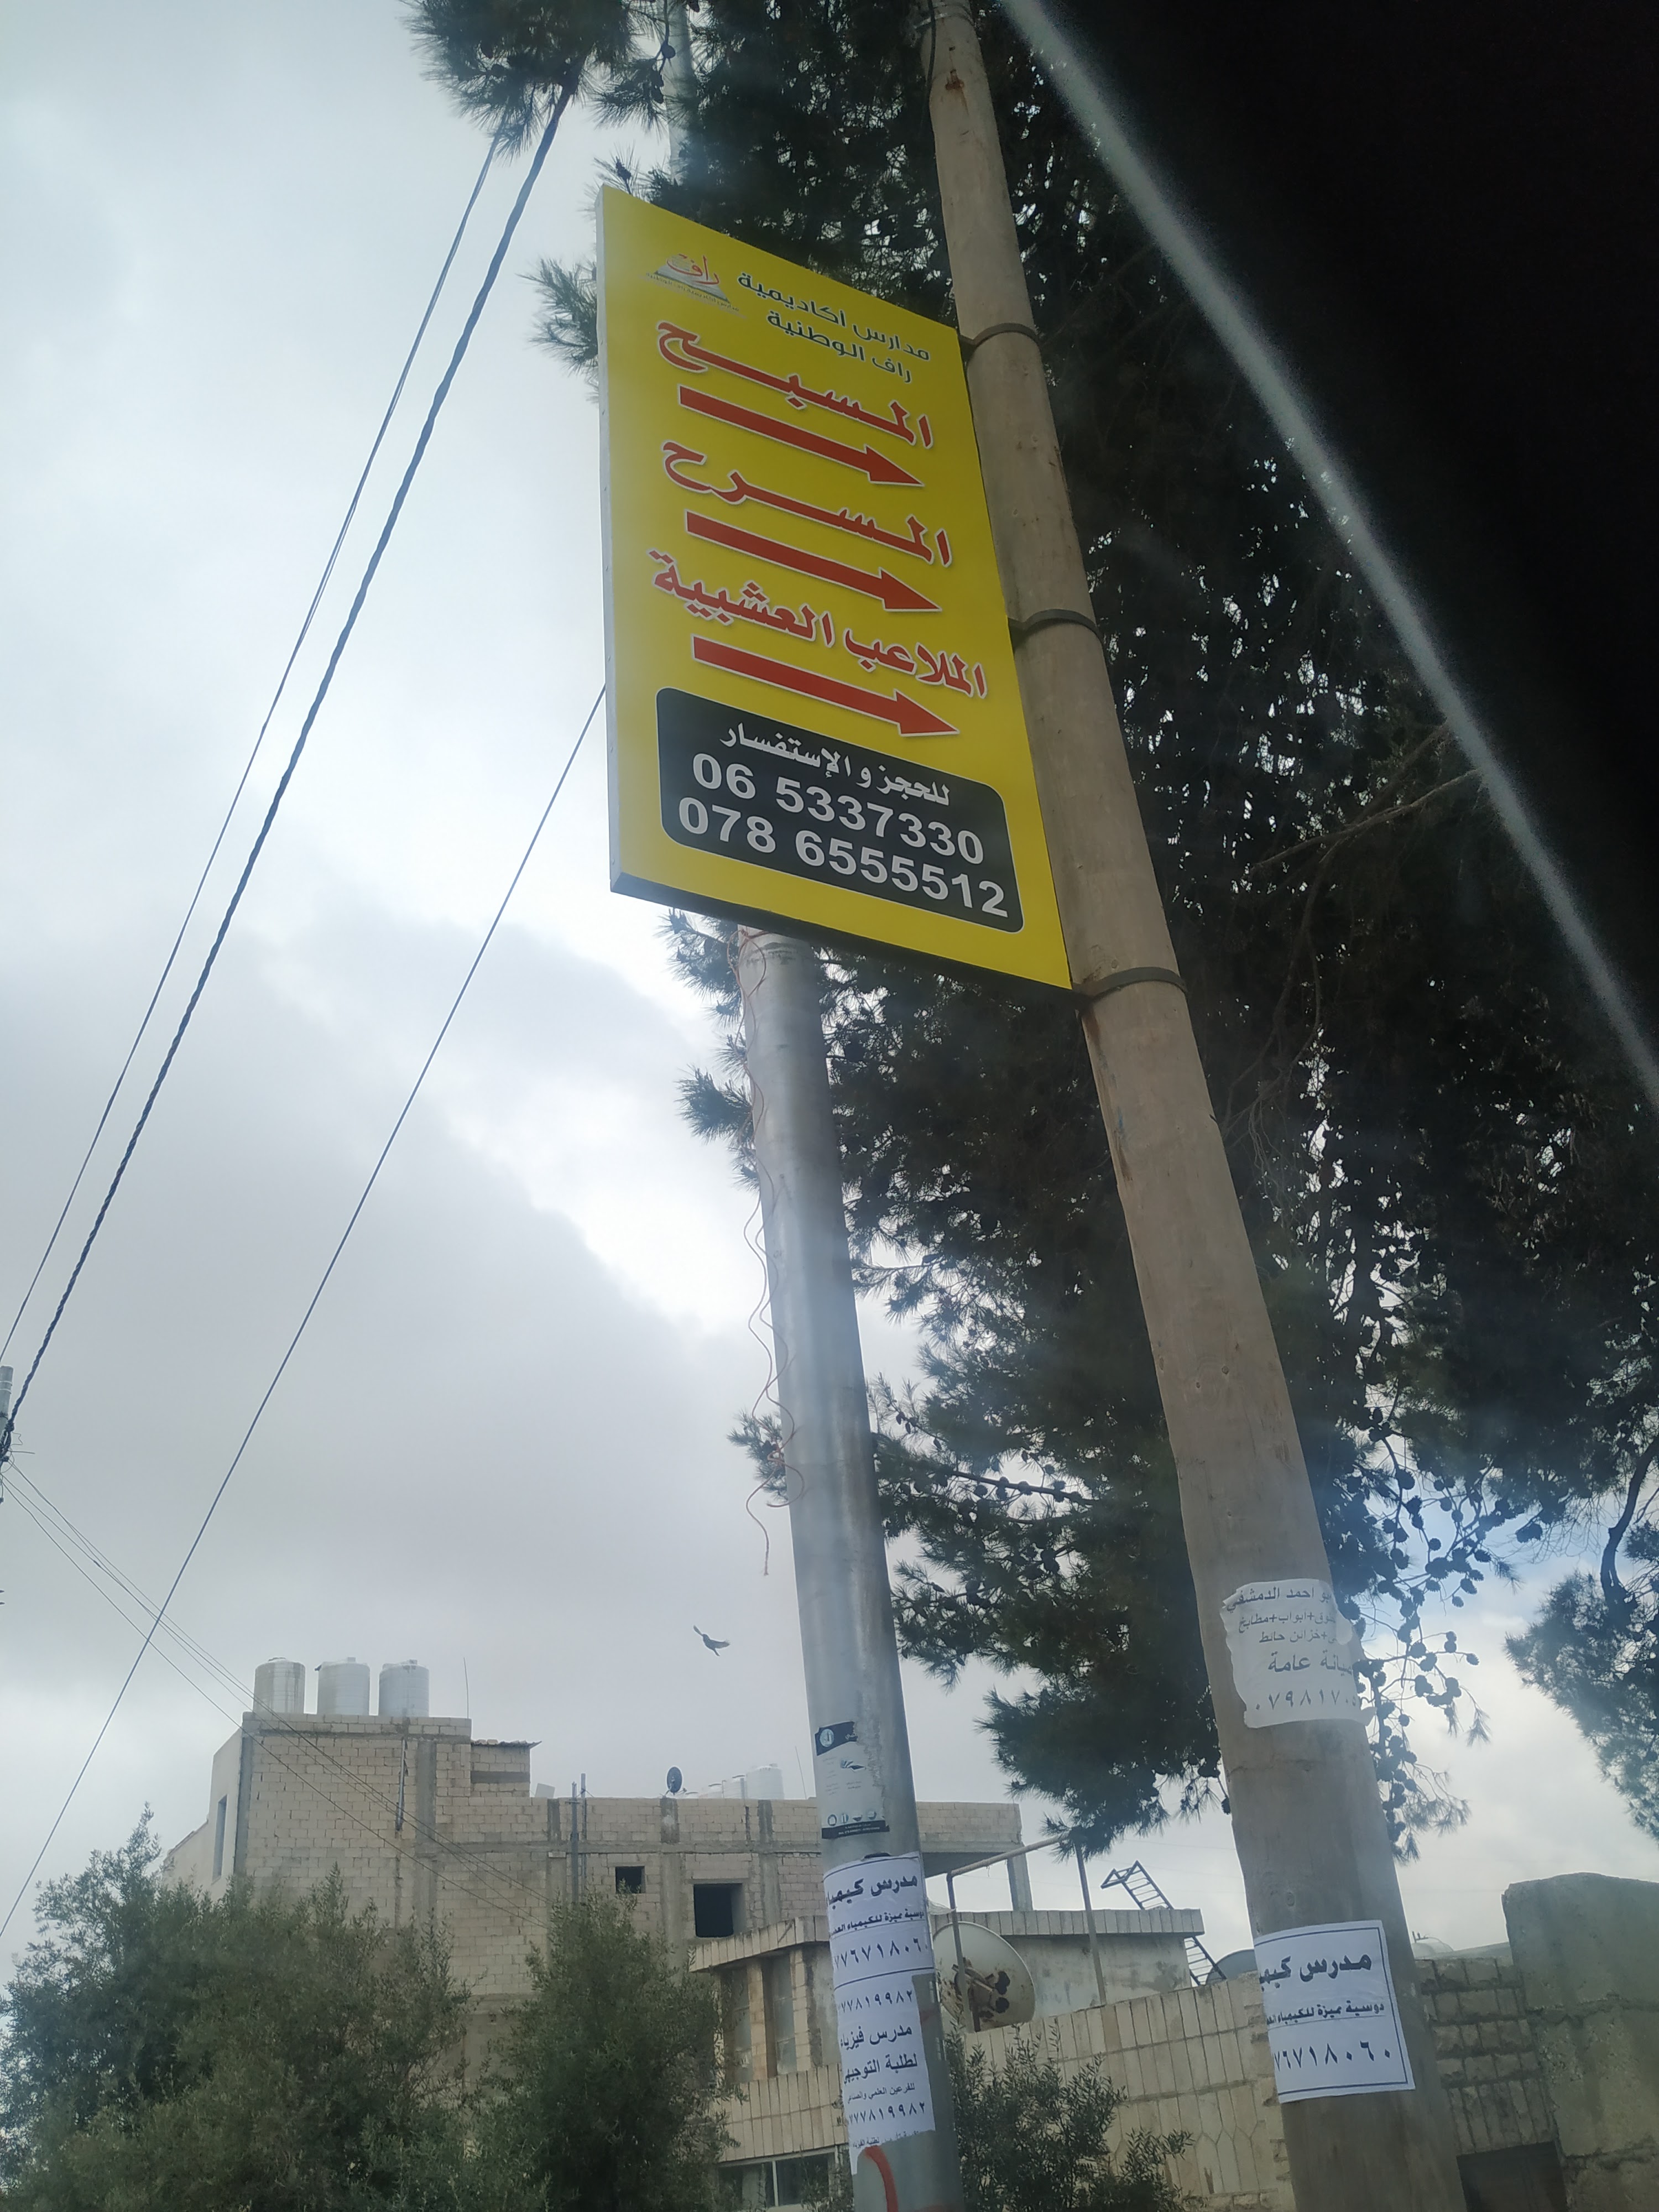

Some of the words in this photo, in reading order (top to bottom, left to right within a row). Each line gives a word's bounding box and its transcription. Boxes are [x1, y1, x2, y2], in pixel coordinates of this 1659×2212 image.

[767, 310, 865, 361] الوطنية
[852, 324, 930, 361] مدارس
[871, 357, 911, 383] راف
[656, 321, 933, 449] المسبح
[661, 439, 953, 567] المسرح
[646, 549, 836, 647] العشبية
[843, 627, 988, 698] الملاعب
[855, 766, 872, 789] و
[876, 765, 950, 806] للحجز
[692, 753, 757, 800] 06
[775, 775, 984, 865] 5337330
[678, 796, 776, 854] 078
[795, 830, 1009, 918] 6555512
[1286, 1586, 1314, 1599] احمد
[1267, 1651, 1311, 1673] عامة
[870, 1875, 918, 1897] مدرس
[847, 1913, 883, 1931] للكيمياء
[1300, 1954, 1372, 1983] مدرس
[1345, 2000, 1385, 2017] دوسية
[869, 2025, 912, 2046] مدرس
[885, 2053, 918, 2074] لطلبة
[868, 2086, 887, 2100] العلمي
[889, 2082, 915, 2096] للفرعين
